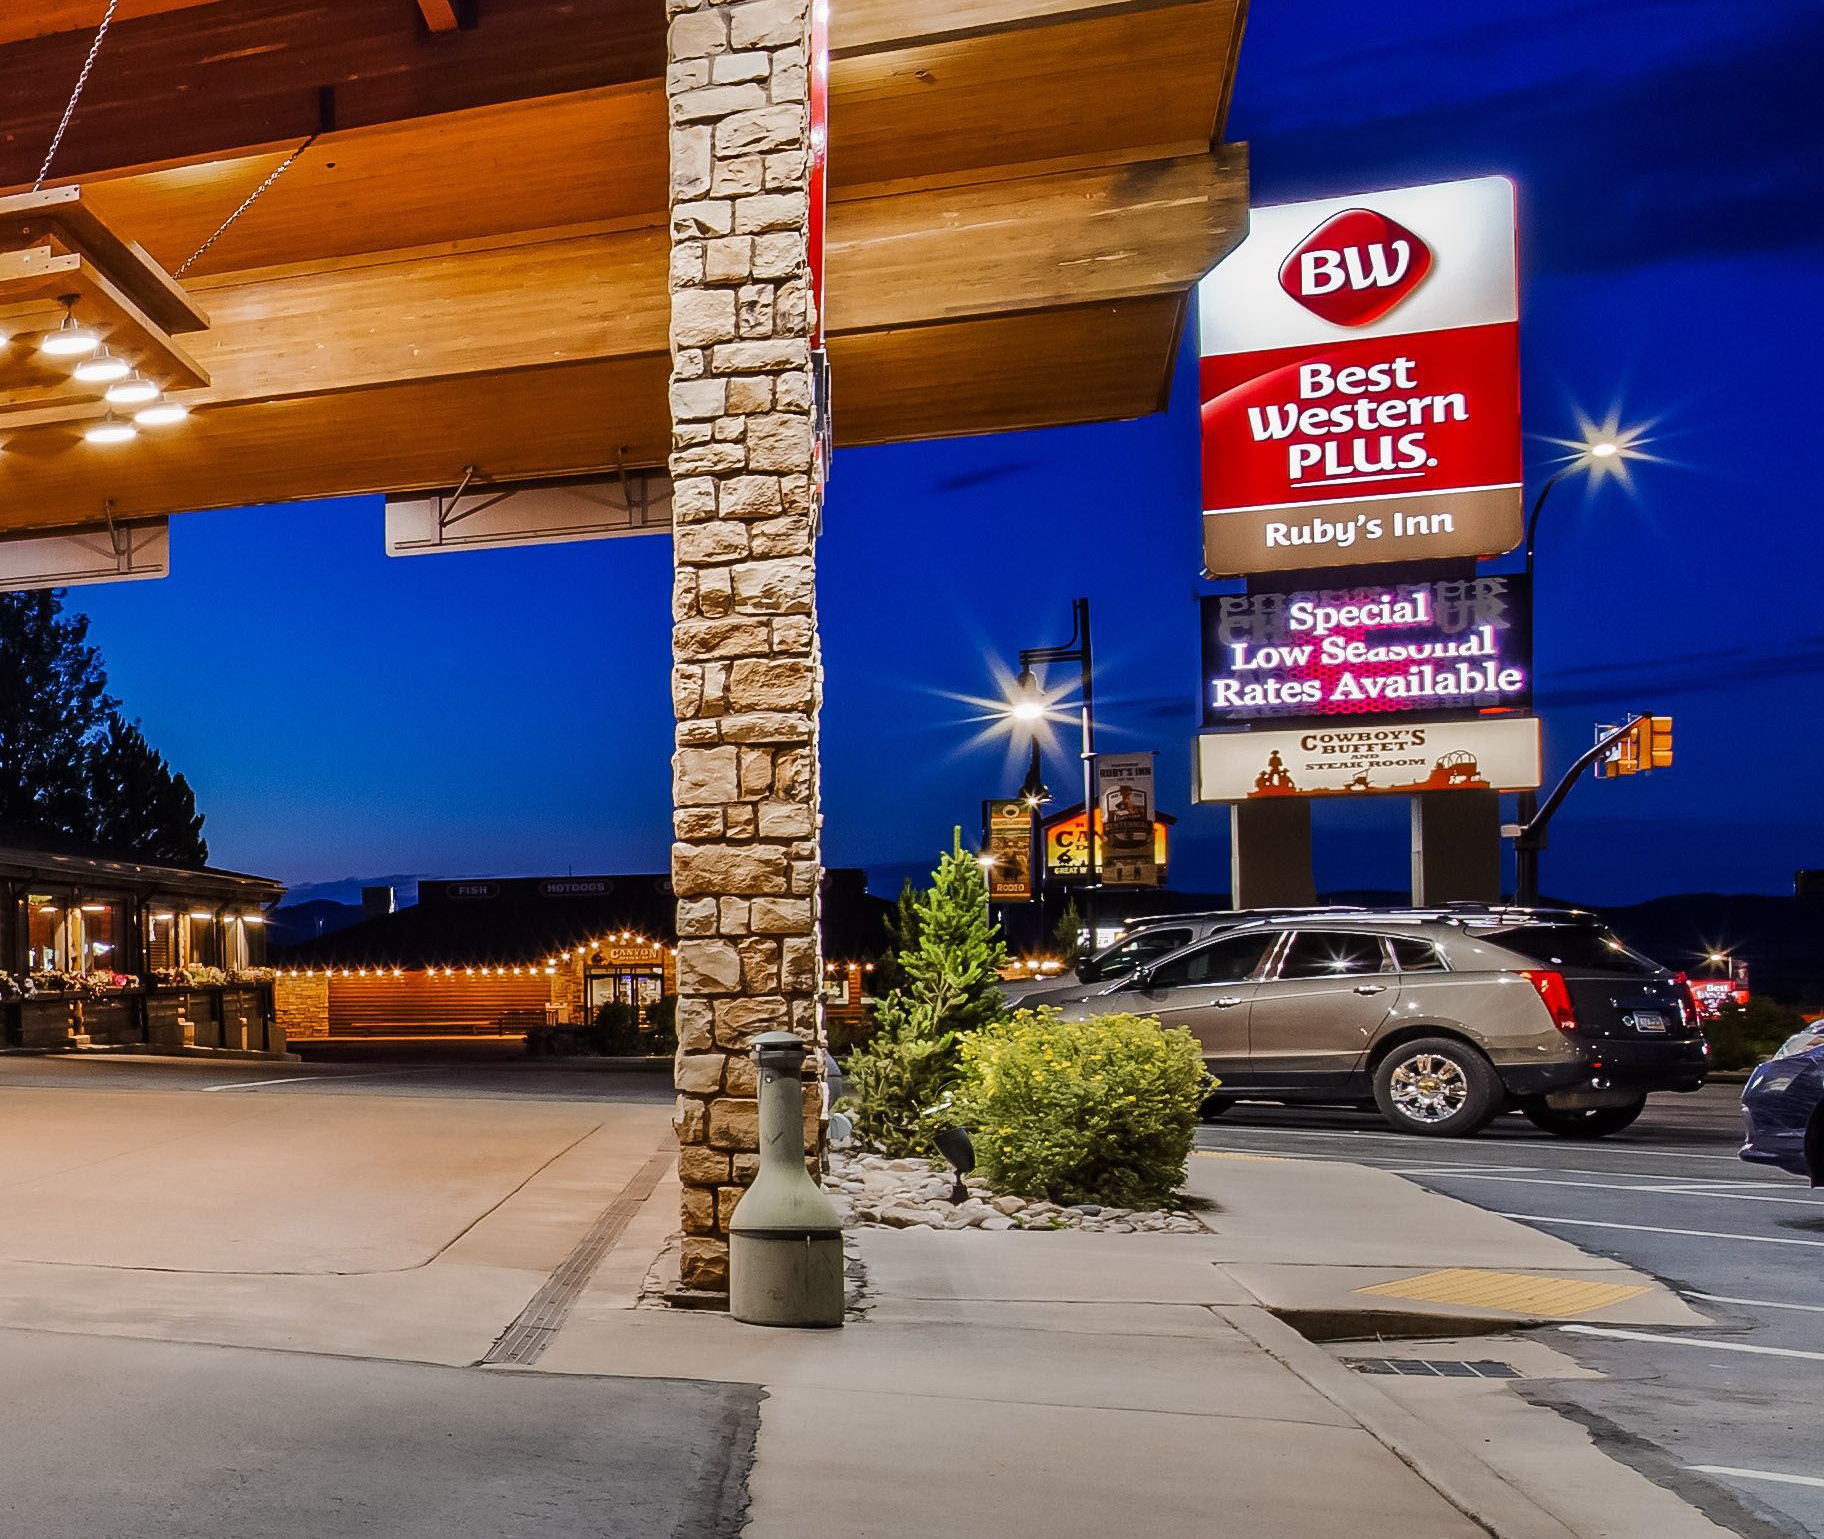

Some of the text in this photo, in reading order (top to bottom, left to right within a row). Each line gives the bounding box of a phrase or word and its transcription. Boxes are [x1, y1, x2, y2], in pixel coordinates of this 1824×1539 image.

[1300, 238, 1410, 297] BW
[1300, 357, 1417, 398] Best
[1248, 393, 1469, 441] Western
[1266, 512, 1454, 547] Ruby's Inn
[1290, 592, 1429, 634] Special
[1231, 642, 1312, 670] Low
[1213, 662, 1523, 707] Rates Available
[1300, 729, 1426, 752] COWBOY'S
[1321, 742, 1408, 755] BUFFET
[1100, 768, 1133, 777] RUBY'S
[1305, 758, 1426, 770] STEAK ROOM
[459, 886, 487, 895] FISH
[610, 949, 657, 959] CANYON
